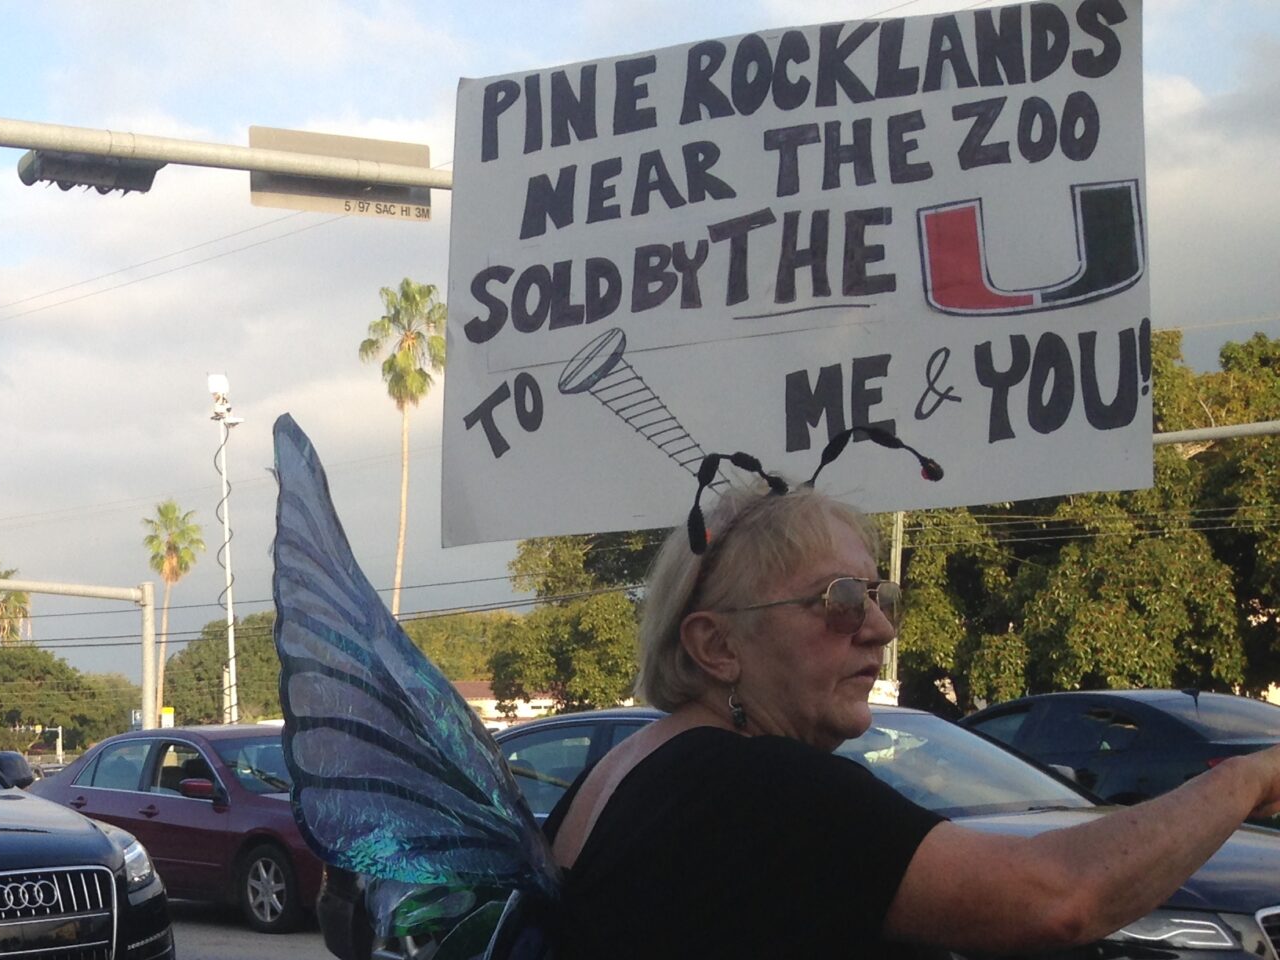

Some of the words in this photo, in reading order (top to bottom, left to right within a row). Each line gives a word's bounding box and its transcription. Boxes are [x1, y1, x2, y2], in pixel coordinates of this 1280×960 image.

[481, 55, 657, 162] PINE
[680, 0, 1128, 125] ROCKLANDS
[375, 203, 396, 215] SAC
[400, 206, 411, 216] HI
[415, 207, 430, 219] 3M
[520, 141, 736, 239] NEAR
[764, 111, 933, 197] THE
[952, 91, 1100, 170] ZOO
[464, 257, 622, 343] SOLD
[631, 240, 708, 313] BY
[707, 207, 896, 305] THE
[916, 179, 1146, 317] U
[463, 373, 543, 458] TO
[785, 354, 896, 453] ME
[914, 347, 962, 420] &
[974, 318, 1152, 443] YOU!
